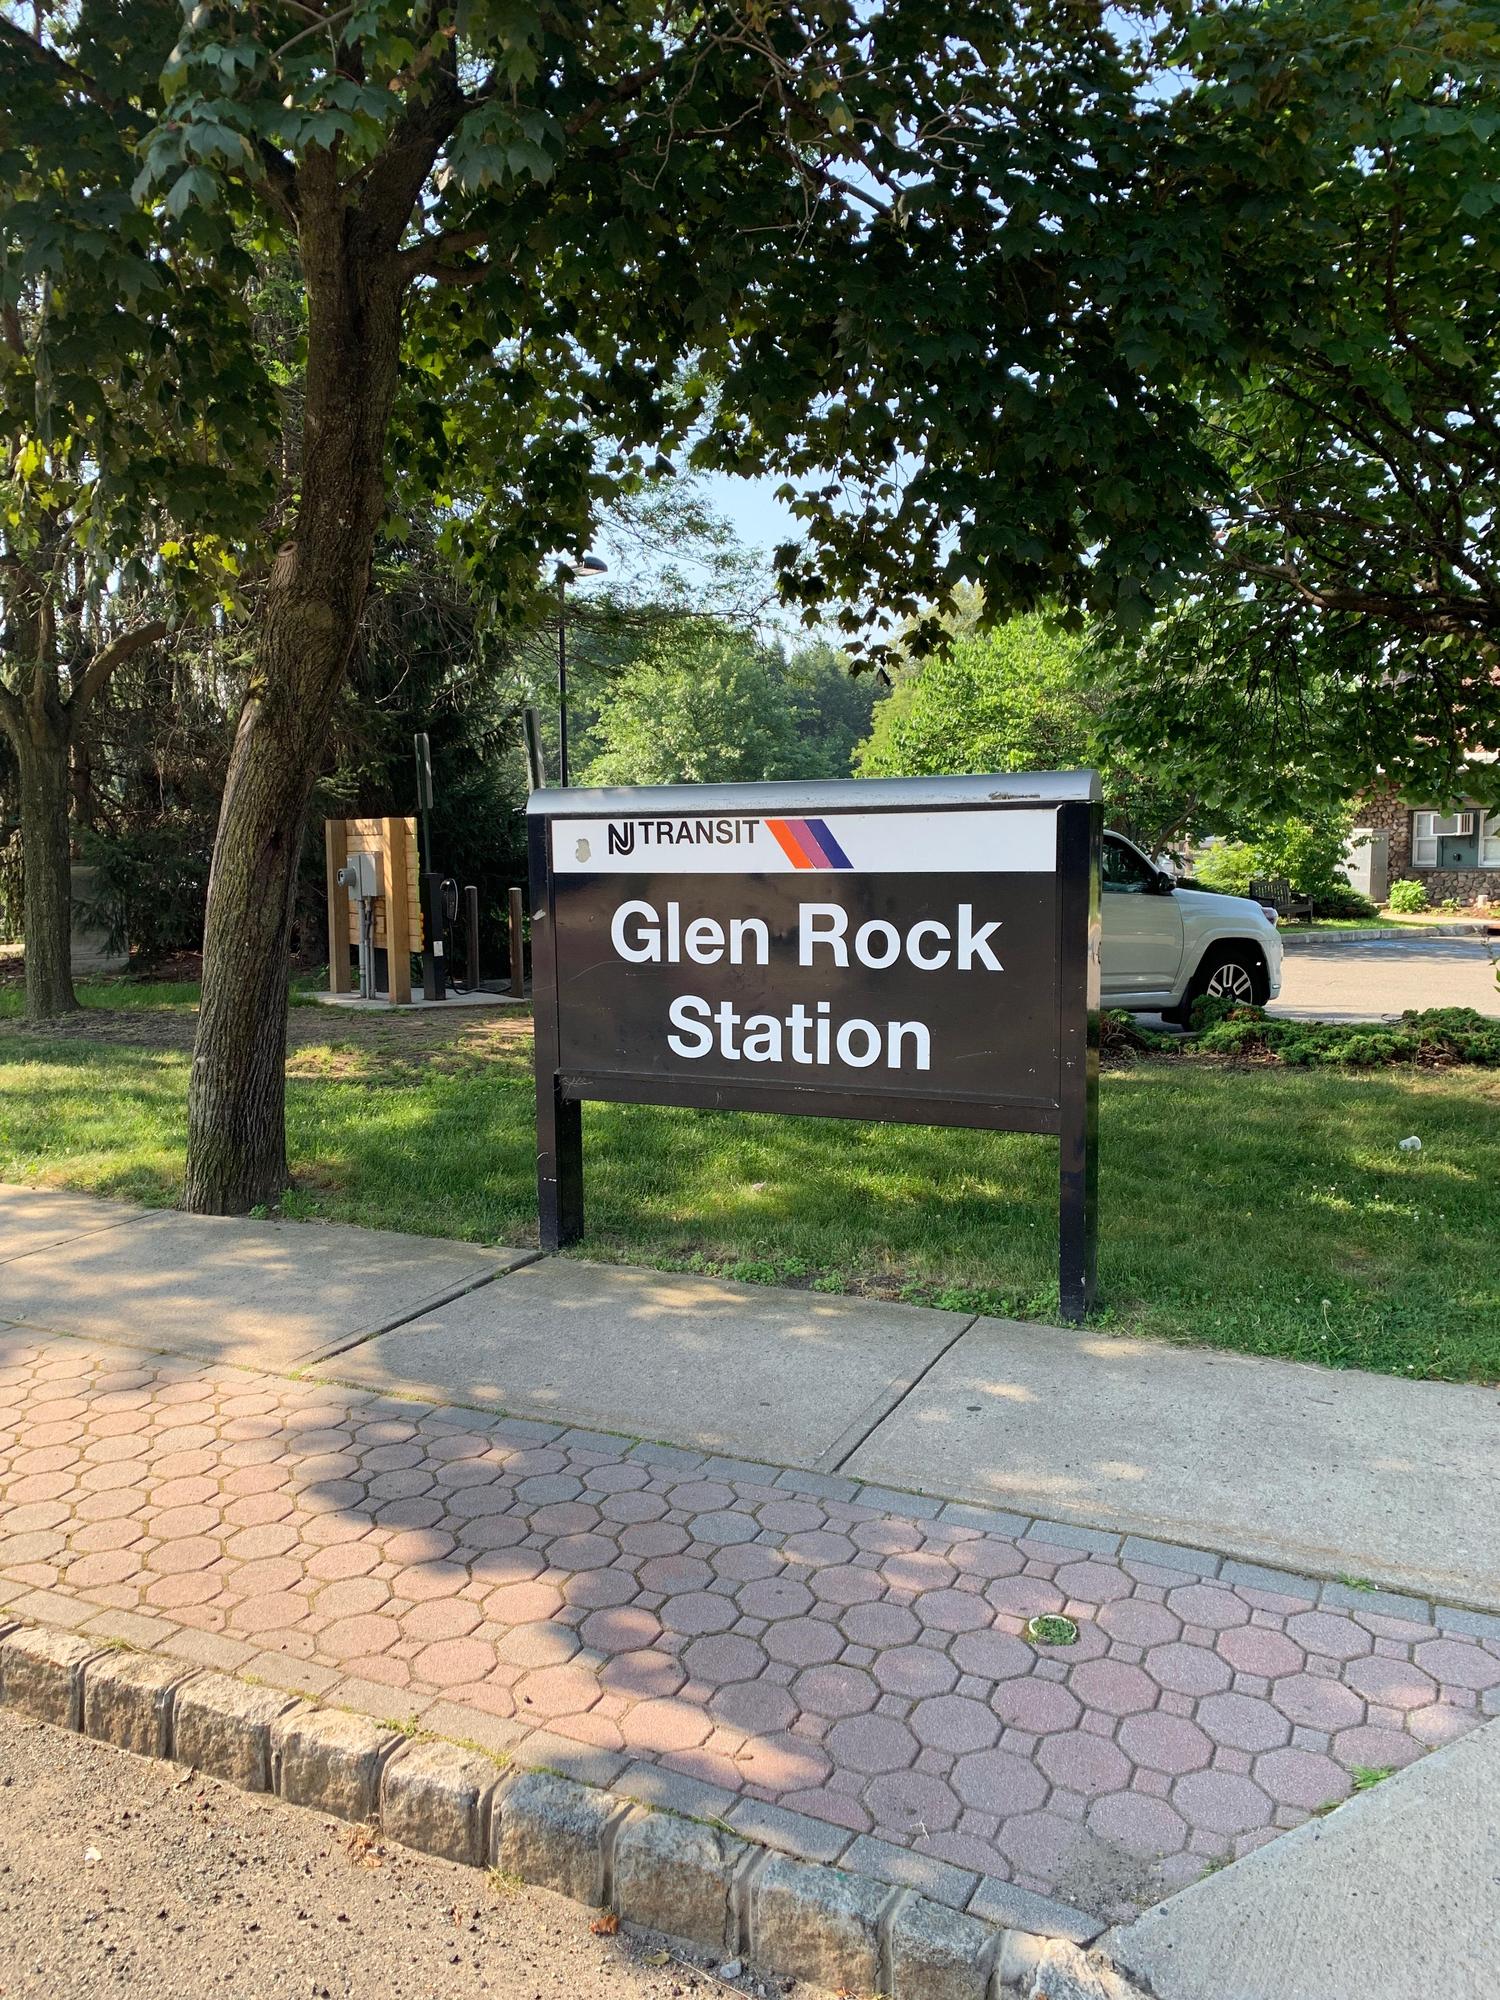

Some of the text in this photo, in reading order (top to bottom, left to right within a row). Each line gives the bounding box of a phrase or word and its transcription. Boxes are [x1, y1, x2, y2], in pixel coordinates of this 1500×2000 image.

[638, 820, 760, 845] TRANSIT
[610, 900, 1005, 972] Glen Rock
[666, 995, 931, 1071] Station
